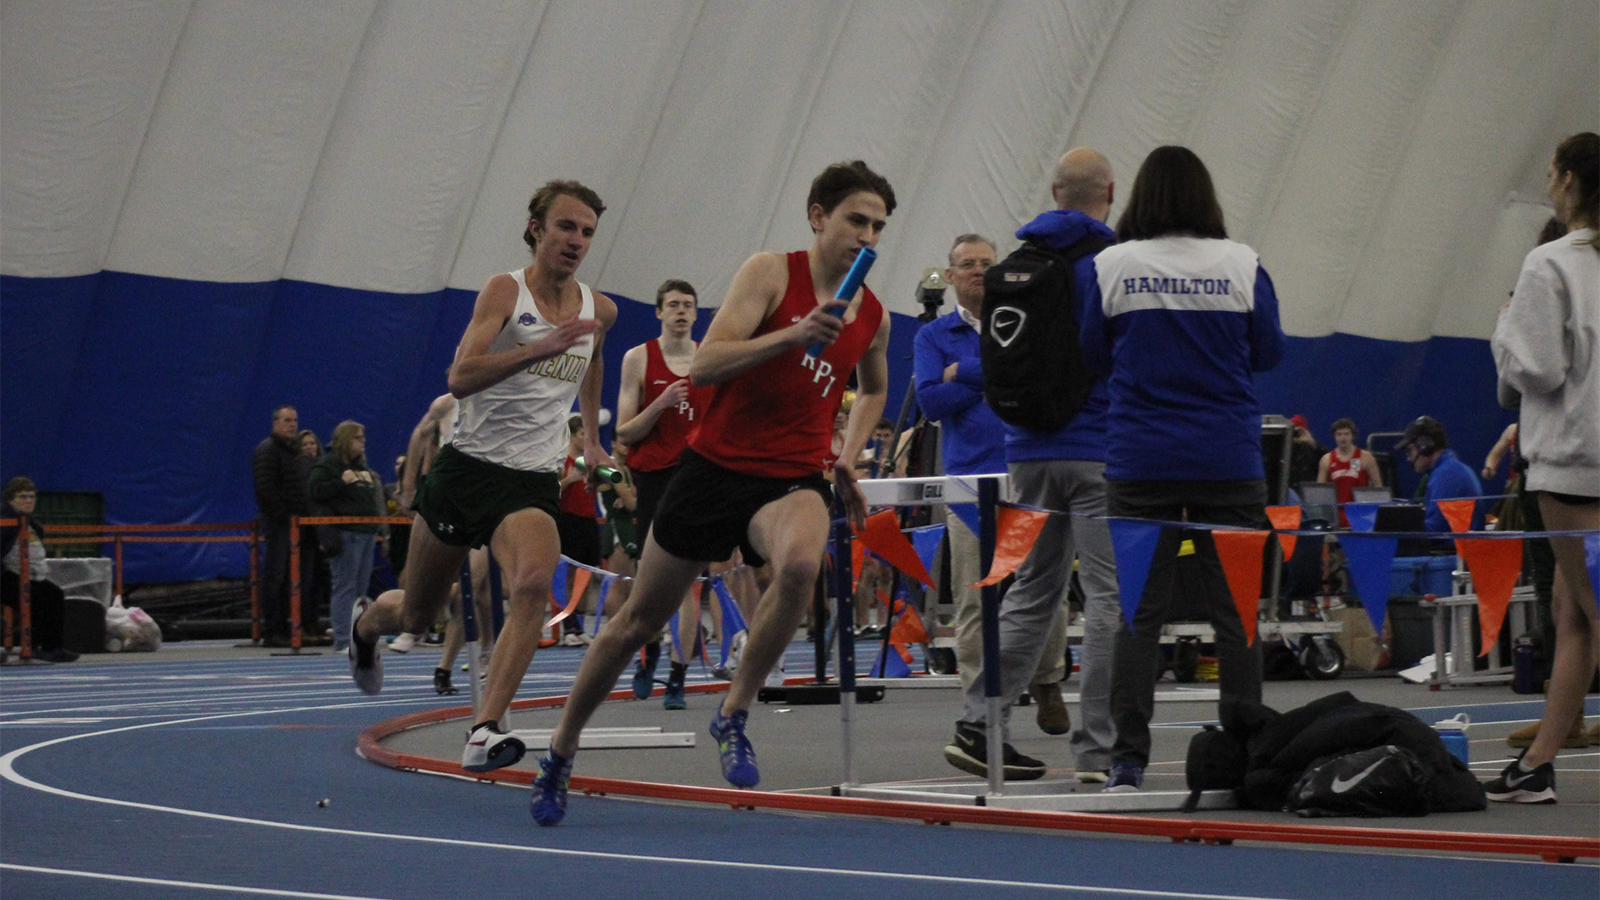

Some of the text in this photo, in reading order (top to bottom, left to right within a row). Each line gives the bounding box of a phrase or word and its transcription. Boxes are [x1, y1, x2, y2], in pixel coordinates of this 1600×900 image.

[1122, 276, 1231, 296] HAMILTON
[526, 353, 588, 384] IENA
[674, 401, 695, 421] PI
